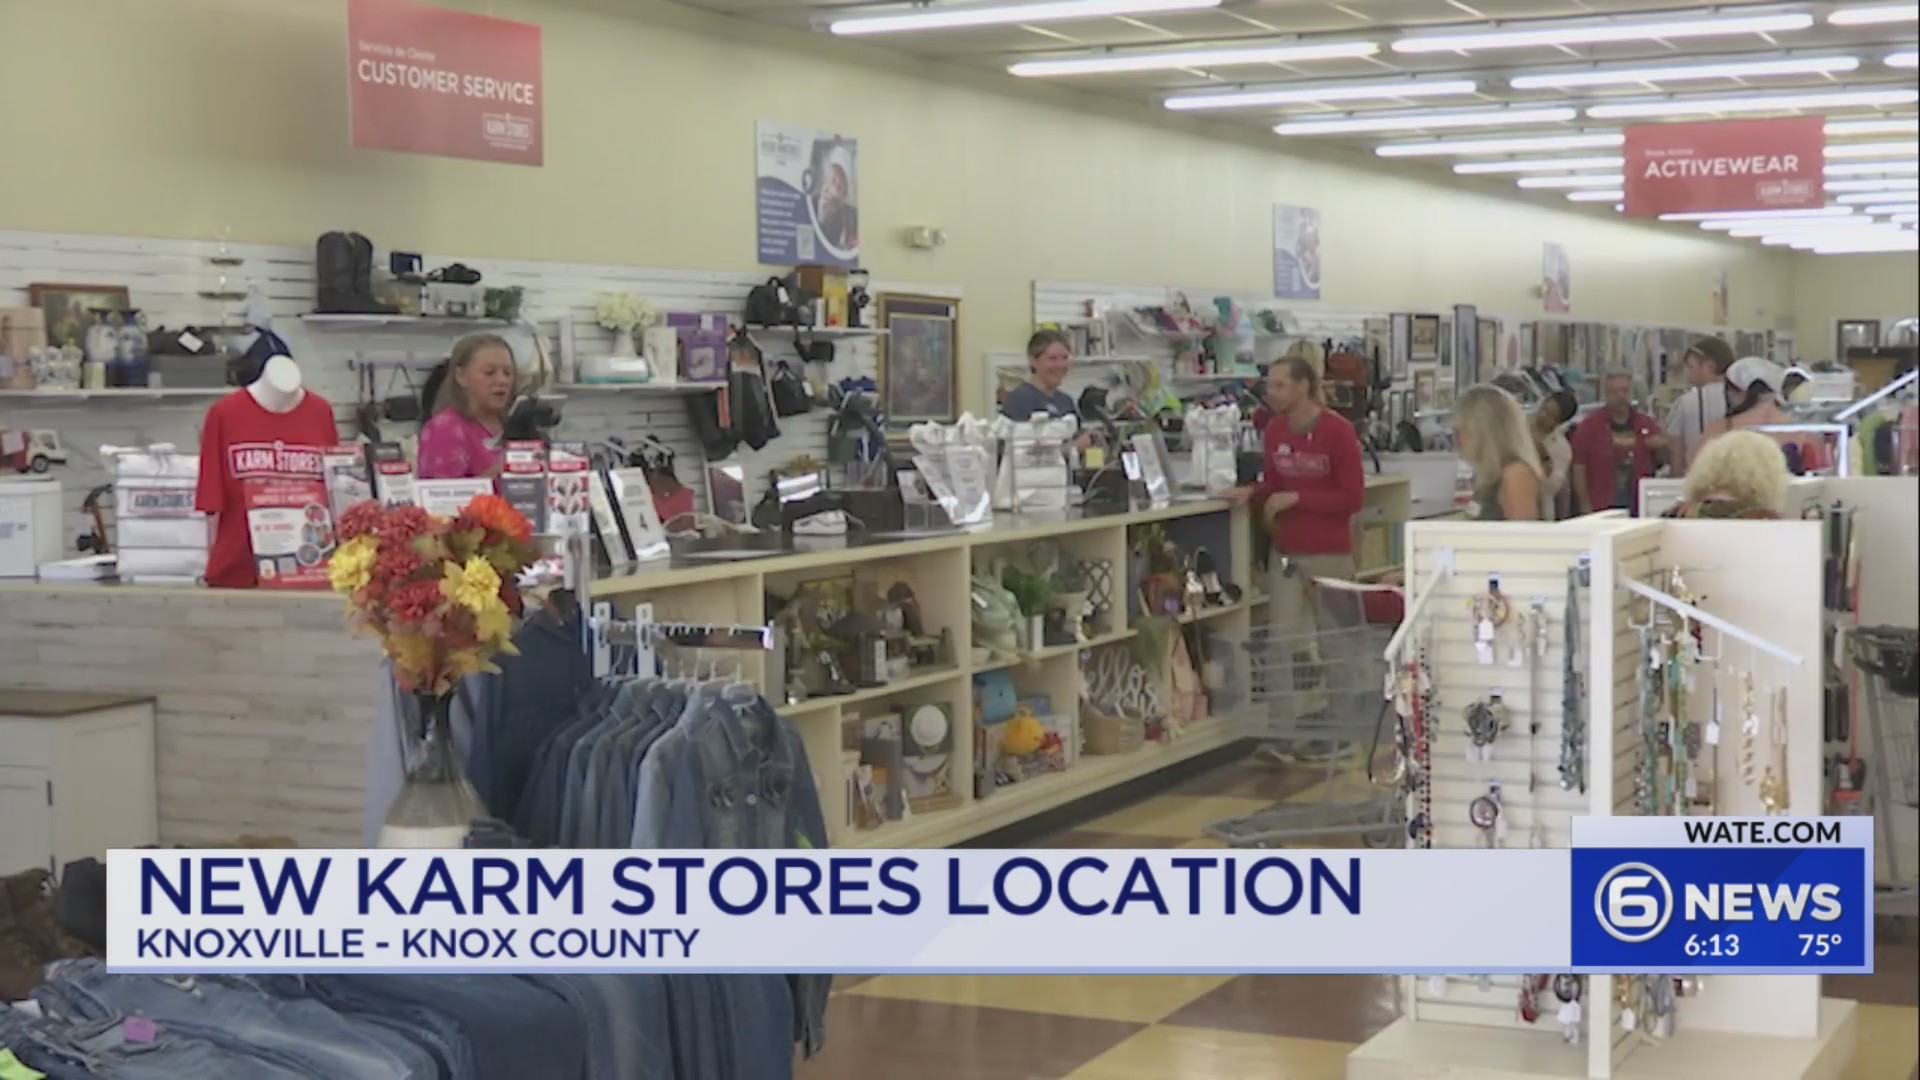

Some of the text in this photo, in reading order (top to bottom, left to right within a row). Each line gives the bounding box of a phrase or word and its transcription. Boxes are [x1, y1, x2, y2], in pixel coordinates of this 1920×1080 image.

[357, 58, 535, 106] CUSTOMER SERVICE
[1644, 154, 1799, 180] ACTIVEWEAR
[234, 449, 322, 473] KARM STORES
